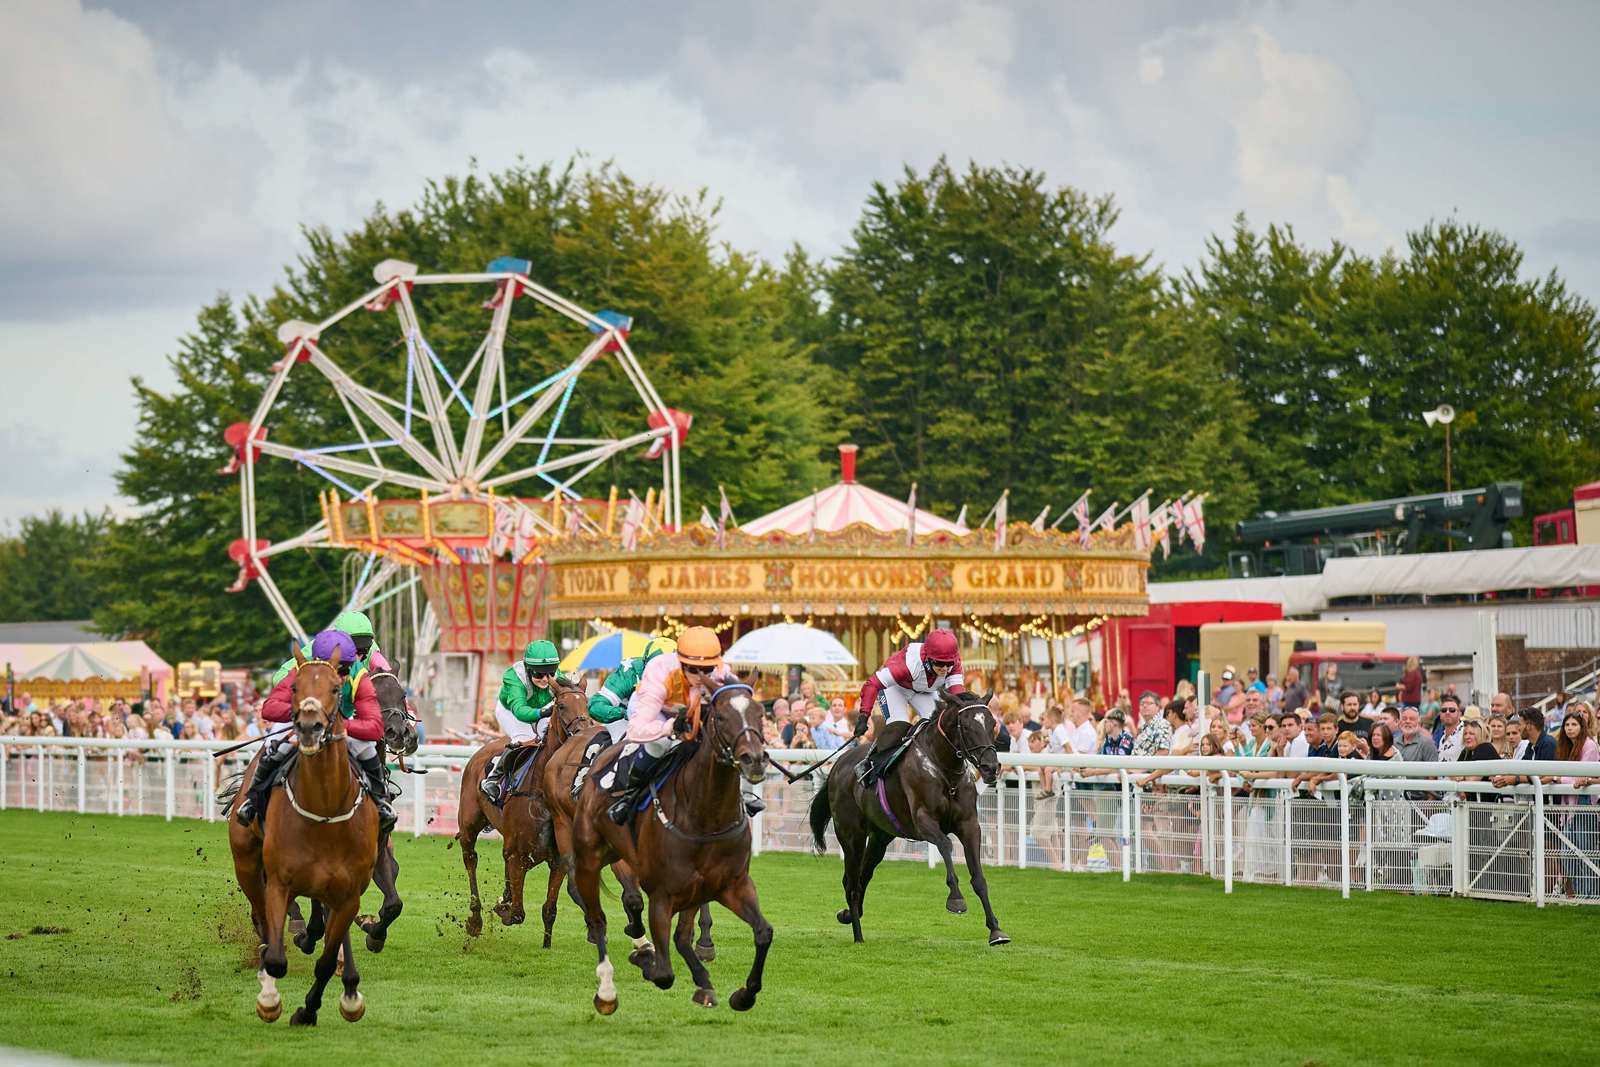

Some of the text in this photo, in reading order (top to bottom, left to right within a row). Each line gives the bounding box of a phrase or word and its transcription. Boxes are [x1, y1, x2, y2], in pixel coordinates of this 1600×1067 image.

[568, 567, 618, 594] TODAY
[658, 566, 751, 590] JAMES
[966, 564, 1056, 588] GRAND
